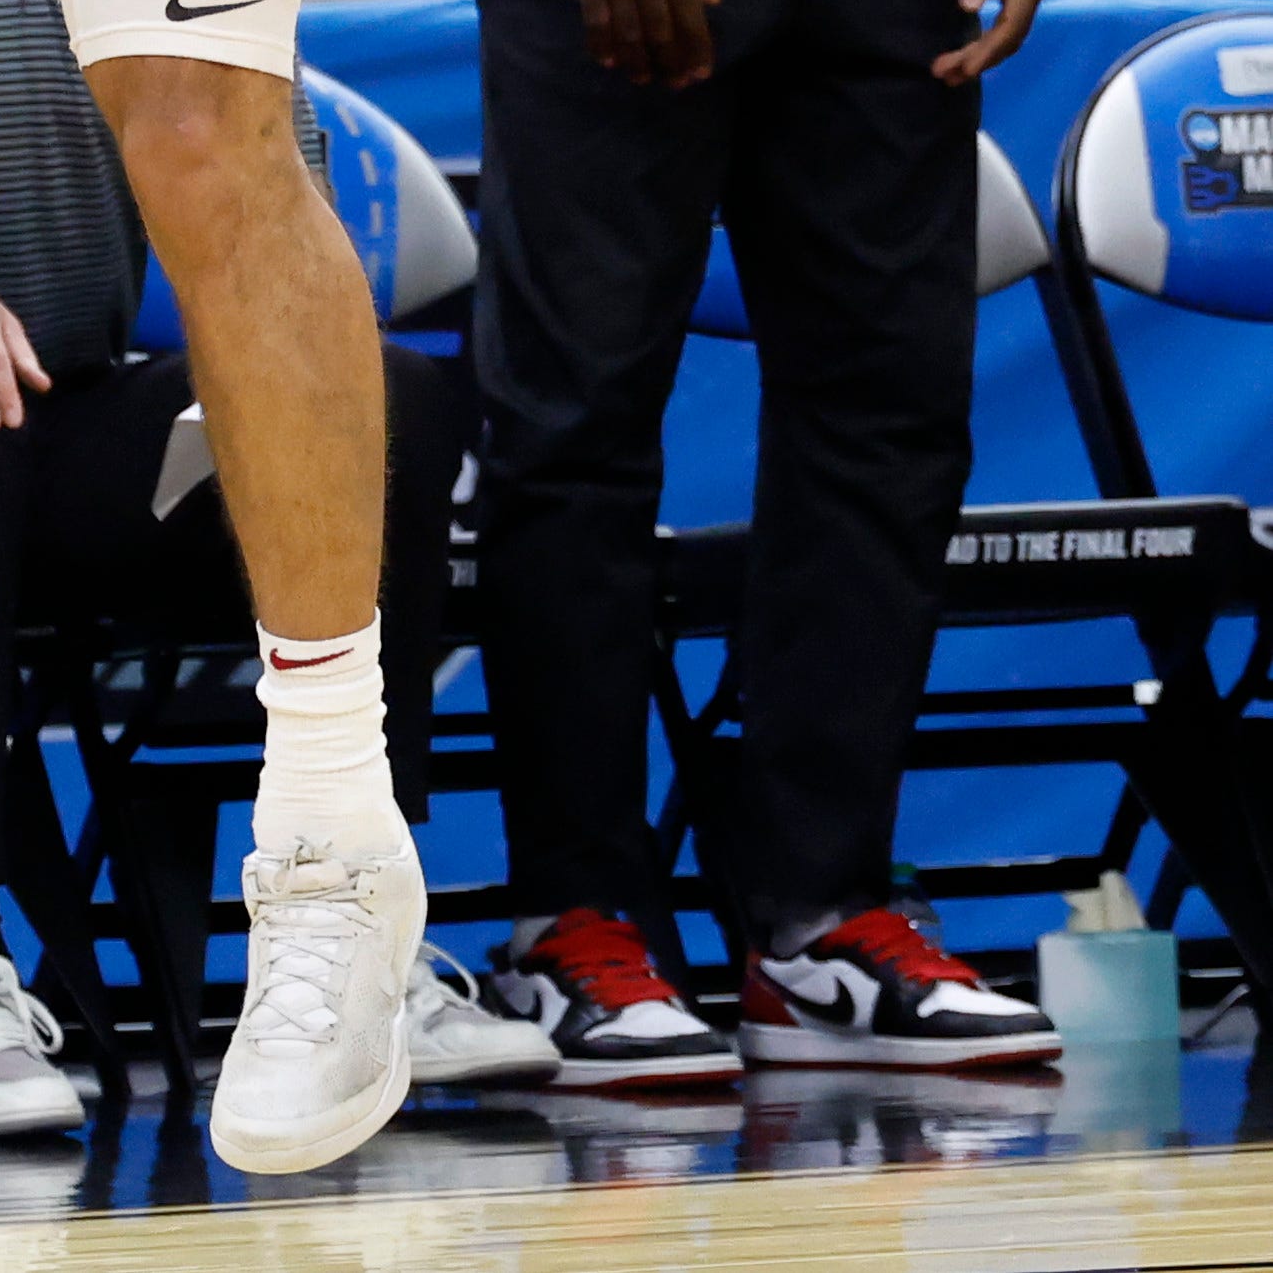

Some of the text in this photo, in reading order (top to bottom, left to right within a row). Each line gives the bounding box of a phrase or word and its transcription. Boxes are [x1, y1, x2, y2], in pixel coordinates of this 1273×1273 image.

[983, 533, 1012, 564] TO
[1017, 531, 1059, 562] THE
[1062, 529, 1126, 561] FINAL
[1132, 526, 1195, 559] FOUR
